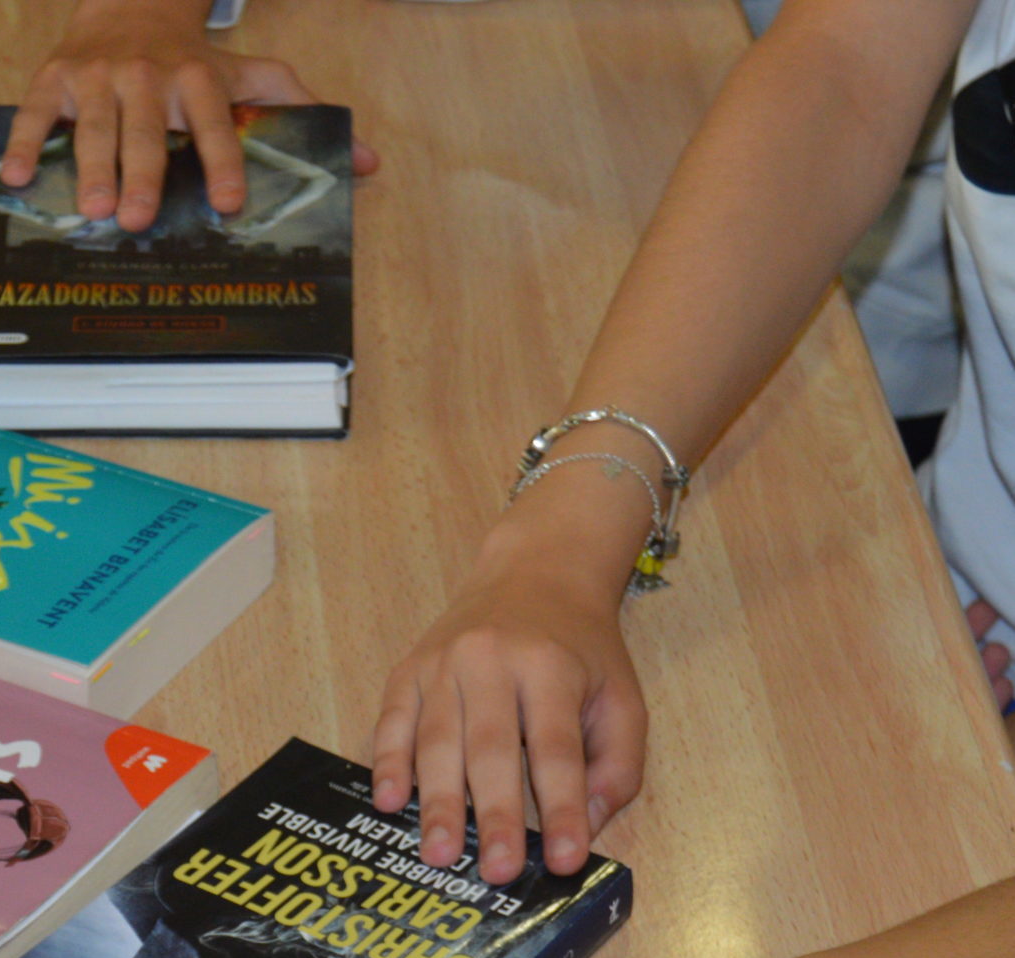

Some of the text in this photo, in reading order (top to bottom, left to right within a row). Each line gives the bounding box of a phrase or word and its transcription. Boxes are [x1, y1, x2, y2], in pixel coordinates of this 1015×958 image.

[148, 284, 182, 306] DE
[188, 279, 318, 308] SOMBRAS
[36, 556, 130, 630] BENAVENT
[257, 800, 381, 864] INVISIBLE
[345, 812, 422, 854] ALEM
[241, 828, 484, 941] CARLSSON
[375, 852, 490, 904] HOMBRE
[484, 891, 524, 918] EL
